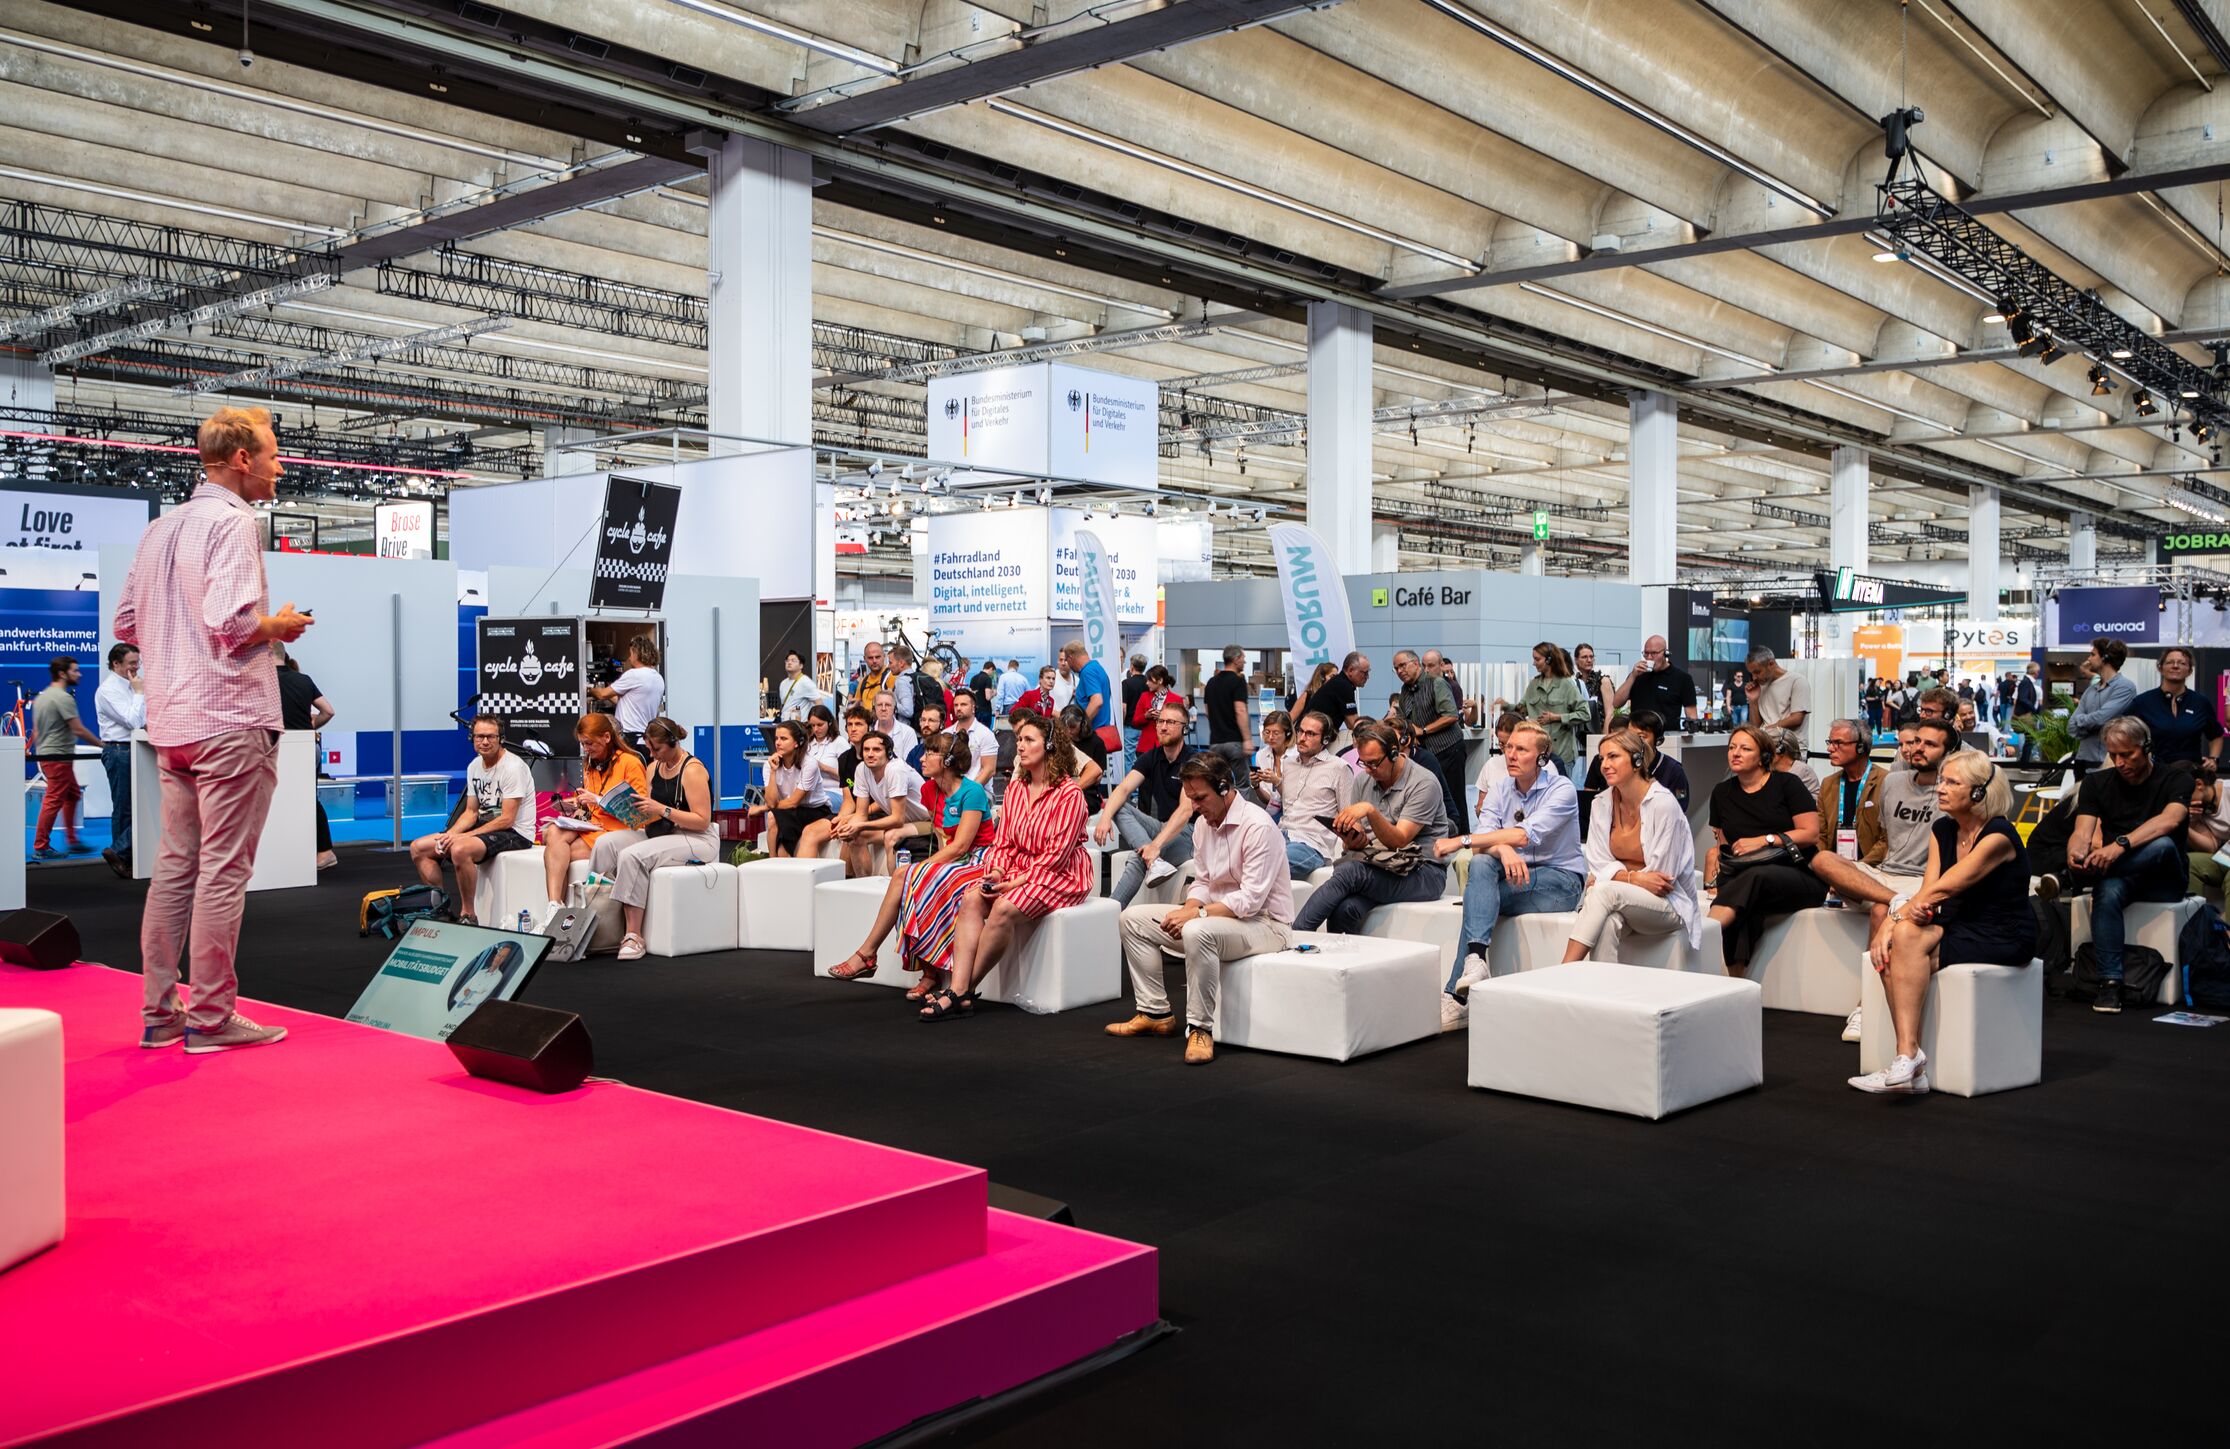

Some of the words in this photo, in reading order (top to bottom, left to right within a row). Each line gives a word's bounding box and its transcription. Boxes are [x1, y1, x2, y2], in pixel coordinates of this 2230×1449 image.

[971, 389, 1033, 406] Bundesministerium
[1092, 393, 1146, 411] Bundesministerium
[971, 406, 980, 418] für
[981, 405, 1010, 418] Digitales
[1092, 405, 1101, 416] für
[1102, 407, 1127, 421] Digitales
[971, 418, 984, 429] und
[984, 416, 1009, 428] Verkehr
[1092, 417, 1104, 428] und
[1104, 418, 1127, 432] Verkehr
[20, 503, 74, 534] Love
[391, 511, 421, 533] Brose
[606, 521, 631, 545] cycle
[646, 525, 668, 551] cafe
[2163, 533, 2230, 551] JOBRA
[933, 566, 995, 581] Deutschland
[997, 565, 1021, 578] 2030
[1116, 568, 1137, 581] 2030
[933, 585, 970, 601] Digital,
[971, 582, 1028, 599] intelligent,
[1395, 586, 1435, 607] Café
[1441, 586, 1472, 606] Bar
[933, 602, 962, 614] smart
[963, 601, 983, 613] und
[984, 600, 1028, 612] vernetzt
[2093, 620, 2146, 633] eurorad
[484, 655, 518, 680] cycle
[543, 655, 575, 680] cafe
[410, 926, 440, 939] IMPULS
[388, 958, 451, 977] MOBILITÄTSBUDGET
